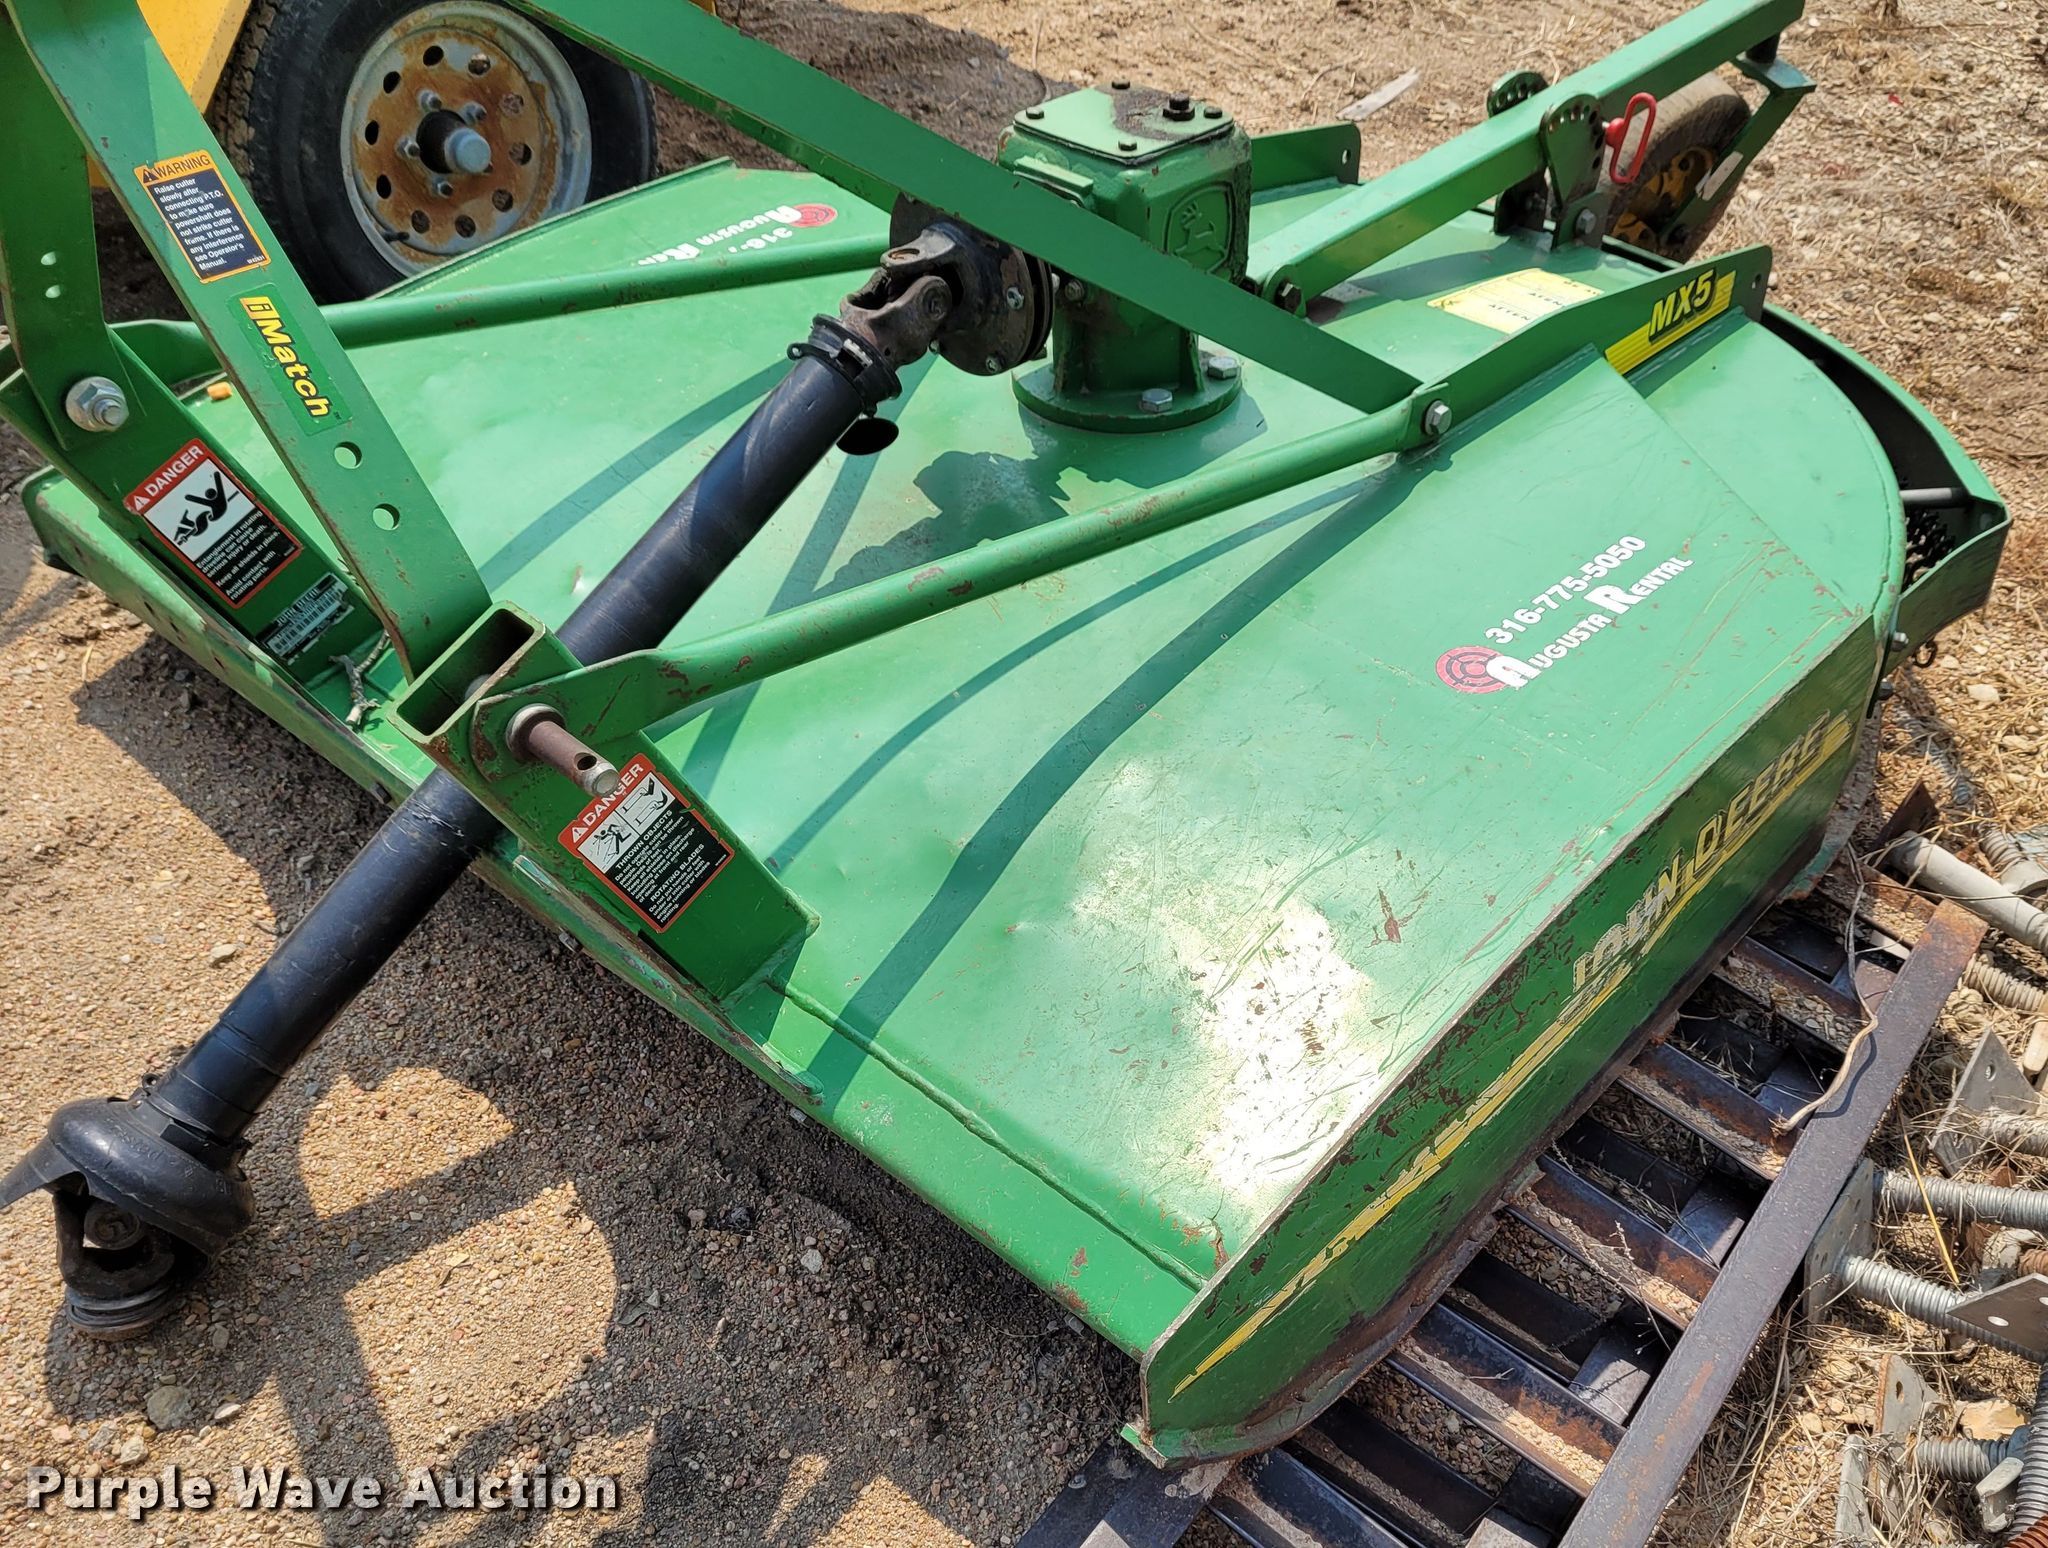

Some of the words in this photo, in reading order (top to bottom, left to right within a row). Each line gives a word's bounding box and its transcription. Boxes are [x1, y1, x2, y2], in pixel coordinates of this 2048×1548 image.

[153, 153, 211, 178] WARNING
[153, 183, 175, 194] Raise
[173, 177, 197, 189] cutter
[158, 191, 184, 204] slowly
[181, 186, 200, 196] after
[163, 194, 205, 213] connecting
[173, 211, 214, 229] powershaft
[212, 206, 232, 217] does
[196, 201, 215, 212] sure
[178, 228, 193, 237] not
[191, 221, 213, 233] strike
[211, 215, 234, 227] cutter
[188, 245, 204, 255] any
[202, 231, 244, 250] interference
[212, 225, 232, 237] there
[193, 253, 208, 262] see
[206, 241, 245, 259] Operator's
[198, 256, 227, 271] Manual.
[1649, 269, 1715, 337] MX5
[239, 296, 331, 419] iMatch
[143, 444, 204, 497] DANGER
[195, 532, 237, 570] Entanglement
[238, 509, 263, 532] rotating
[200, 550, 226, 573] driveline
[224, 541, 237, 553] can
[235, 526, 254, 543] cause
[205, 557, 228, 578] serious
[225, 543, 244, 561] injury
[215, 571, 233, 588] Keep
[229, 565, 240, 575] all
[236, 548, 258, 568] shields
[224, 579, 243, 596] Avoid
[240, 560, 264, 582] contact
[261, 549, 276, 563] with
[229, 578, 254, 601] rotating
[1485, 535, 1647, 644] 316-775-5050
[1485, 611, 1613, 688] AUGUSTA
[1583, 556, 1695, 615] RENTAL
[581, 761, 644, 827] DANGER
[1693, 709, 1833, 872] DEERE
[614, 839, 645, 870] THROWN
[642, 808, 673, 841] OBJECTS
[621, 862, 632, 874] not
[630, 843, 650, 865] operate
[647, 828, 664, 846] cutter
[661, 817, 674, 831] near
[635, 848, 653, 867] Debris
[650, 839, 662, 851] can
[665, 814, 684, 834] thrown
[650, 857, 666, 874] those
[670, 826, 695, 853] discharge
[622, 863, 646, 889] hundreds
[626, 877, 641, 893] Keep
[638, 870, 647, 879] all
[644, 852, 663, 873] shields
[634, 877, 655, 900] opening
[657, 860, 671, 874] front
[668, 850, 680, 862] and
[678, 840, 690, 852] rear
[649, 868, 681, 902] ROTATING
[678, 842, 705, 871] BLADES
[652, 899, 668, 916] under
[670, 884, 682, 896] into
[679, 869, 695, 886] cutter
[693, 858, 705, 871] with
[655, 894, 665, 905] not
[663, 885, 674, 897] put
[671, 870, 688, 888] hands
[690, 854, 702, 866] feet
[655, 901, 673, 920] engine
[670, 882, 691, 904] running
[693, 860, 710, 878] blades
